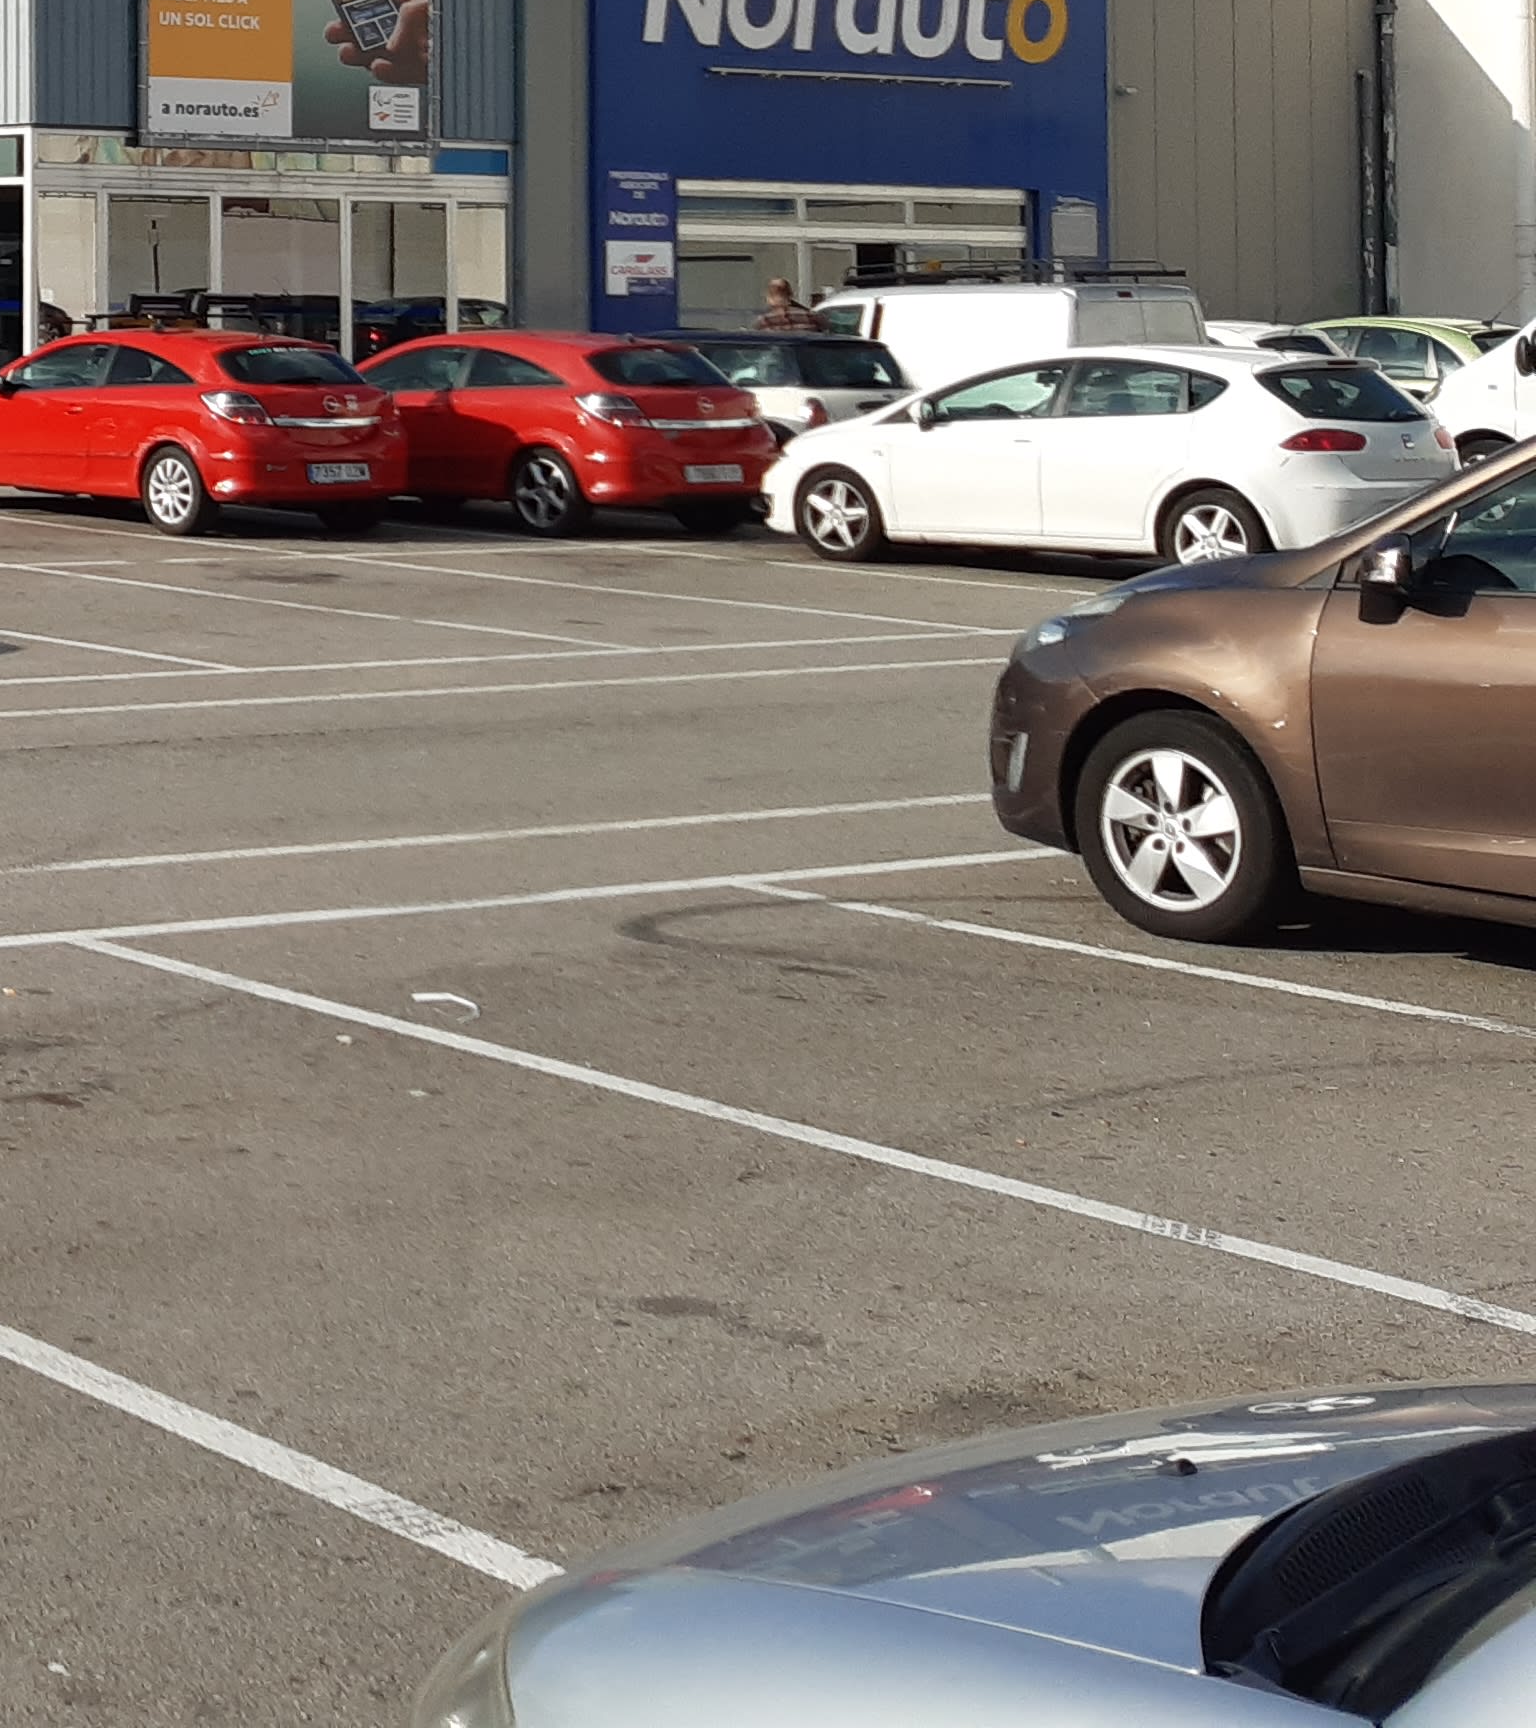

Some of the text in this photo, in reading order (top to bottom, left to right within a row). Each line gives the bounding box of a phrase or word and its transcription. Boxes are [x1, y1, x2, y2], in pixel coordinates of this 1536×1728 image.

[159, 11, 261, 30] UN SOL CLICK
[161, 102, 260, 118] a norauto.es
